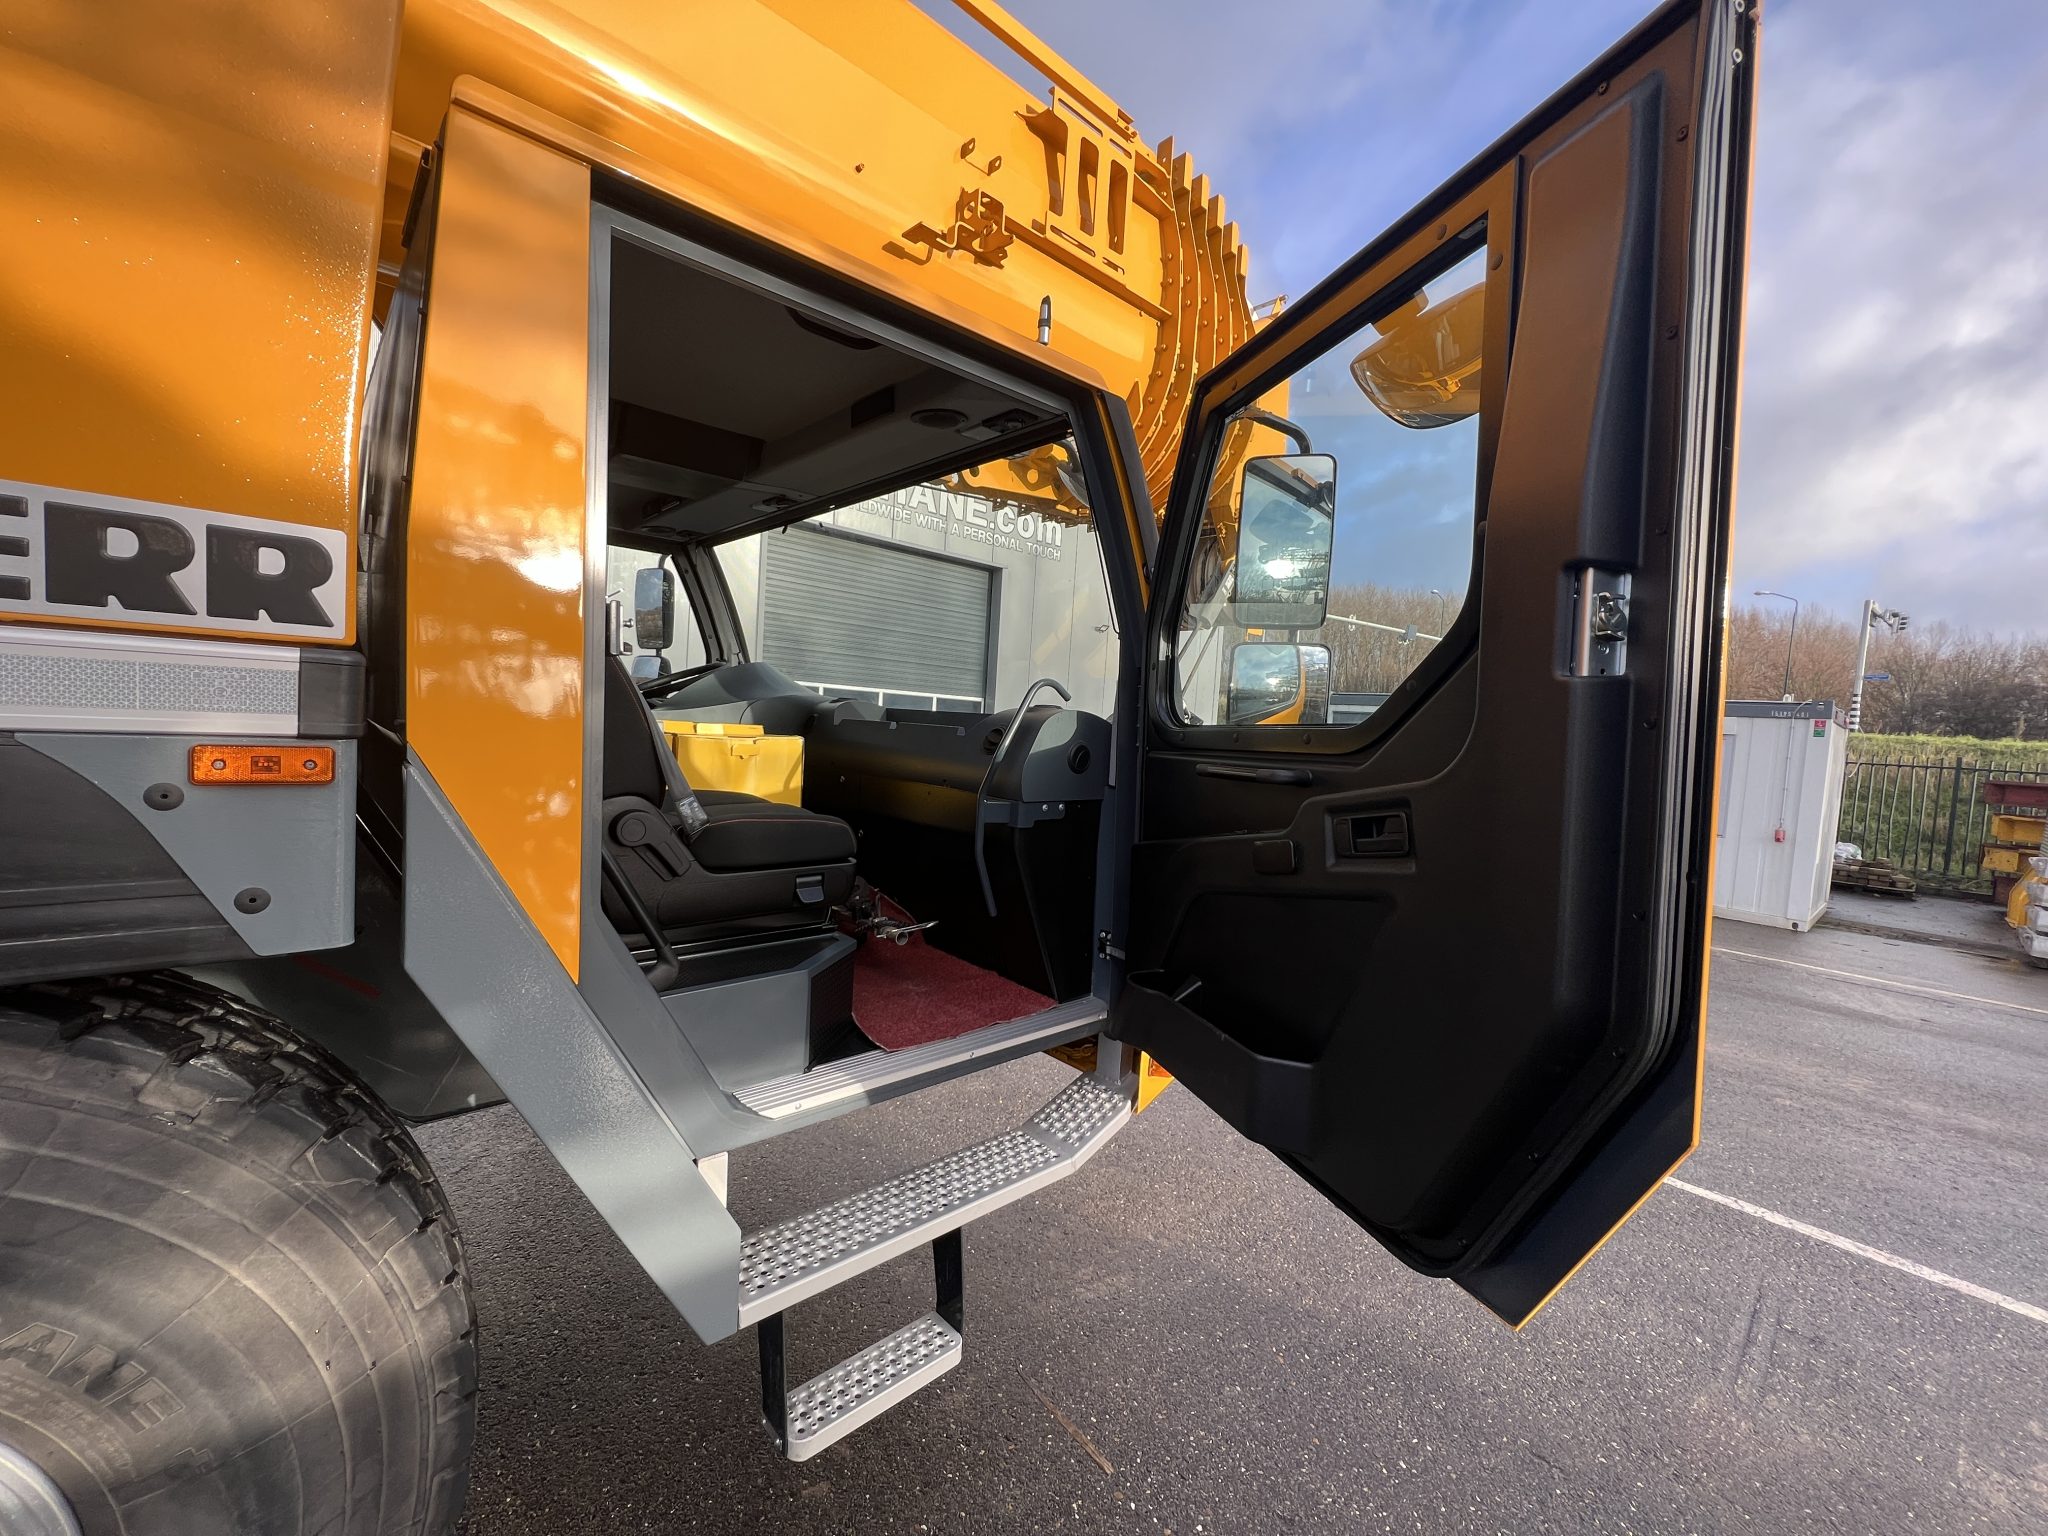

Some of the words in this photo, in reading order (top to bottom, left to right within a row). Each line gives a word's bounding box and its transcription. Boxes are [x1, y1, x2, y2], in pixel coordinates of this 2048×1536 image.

[0, 494, 334, 628] RR
[915, 512, 947, 534] WITH
[951, 523, 961, 538] A
[963, 526, 1023, 552] PERSONAL
[1026, 542, 1062, 561] TOUCH
